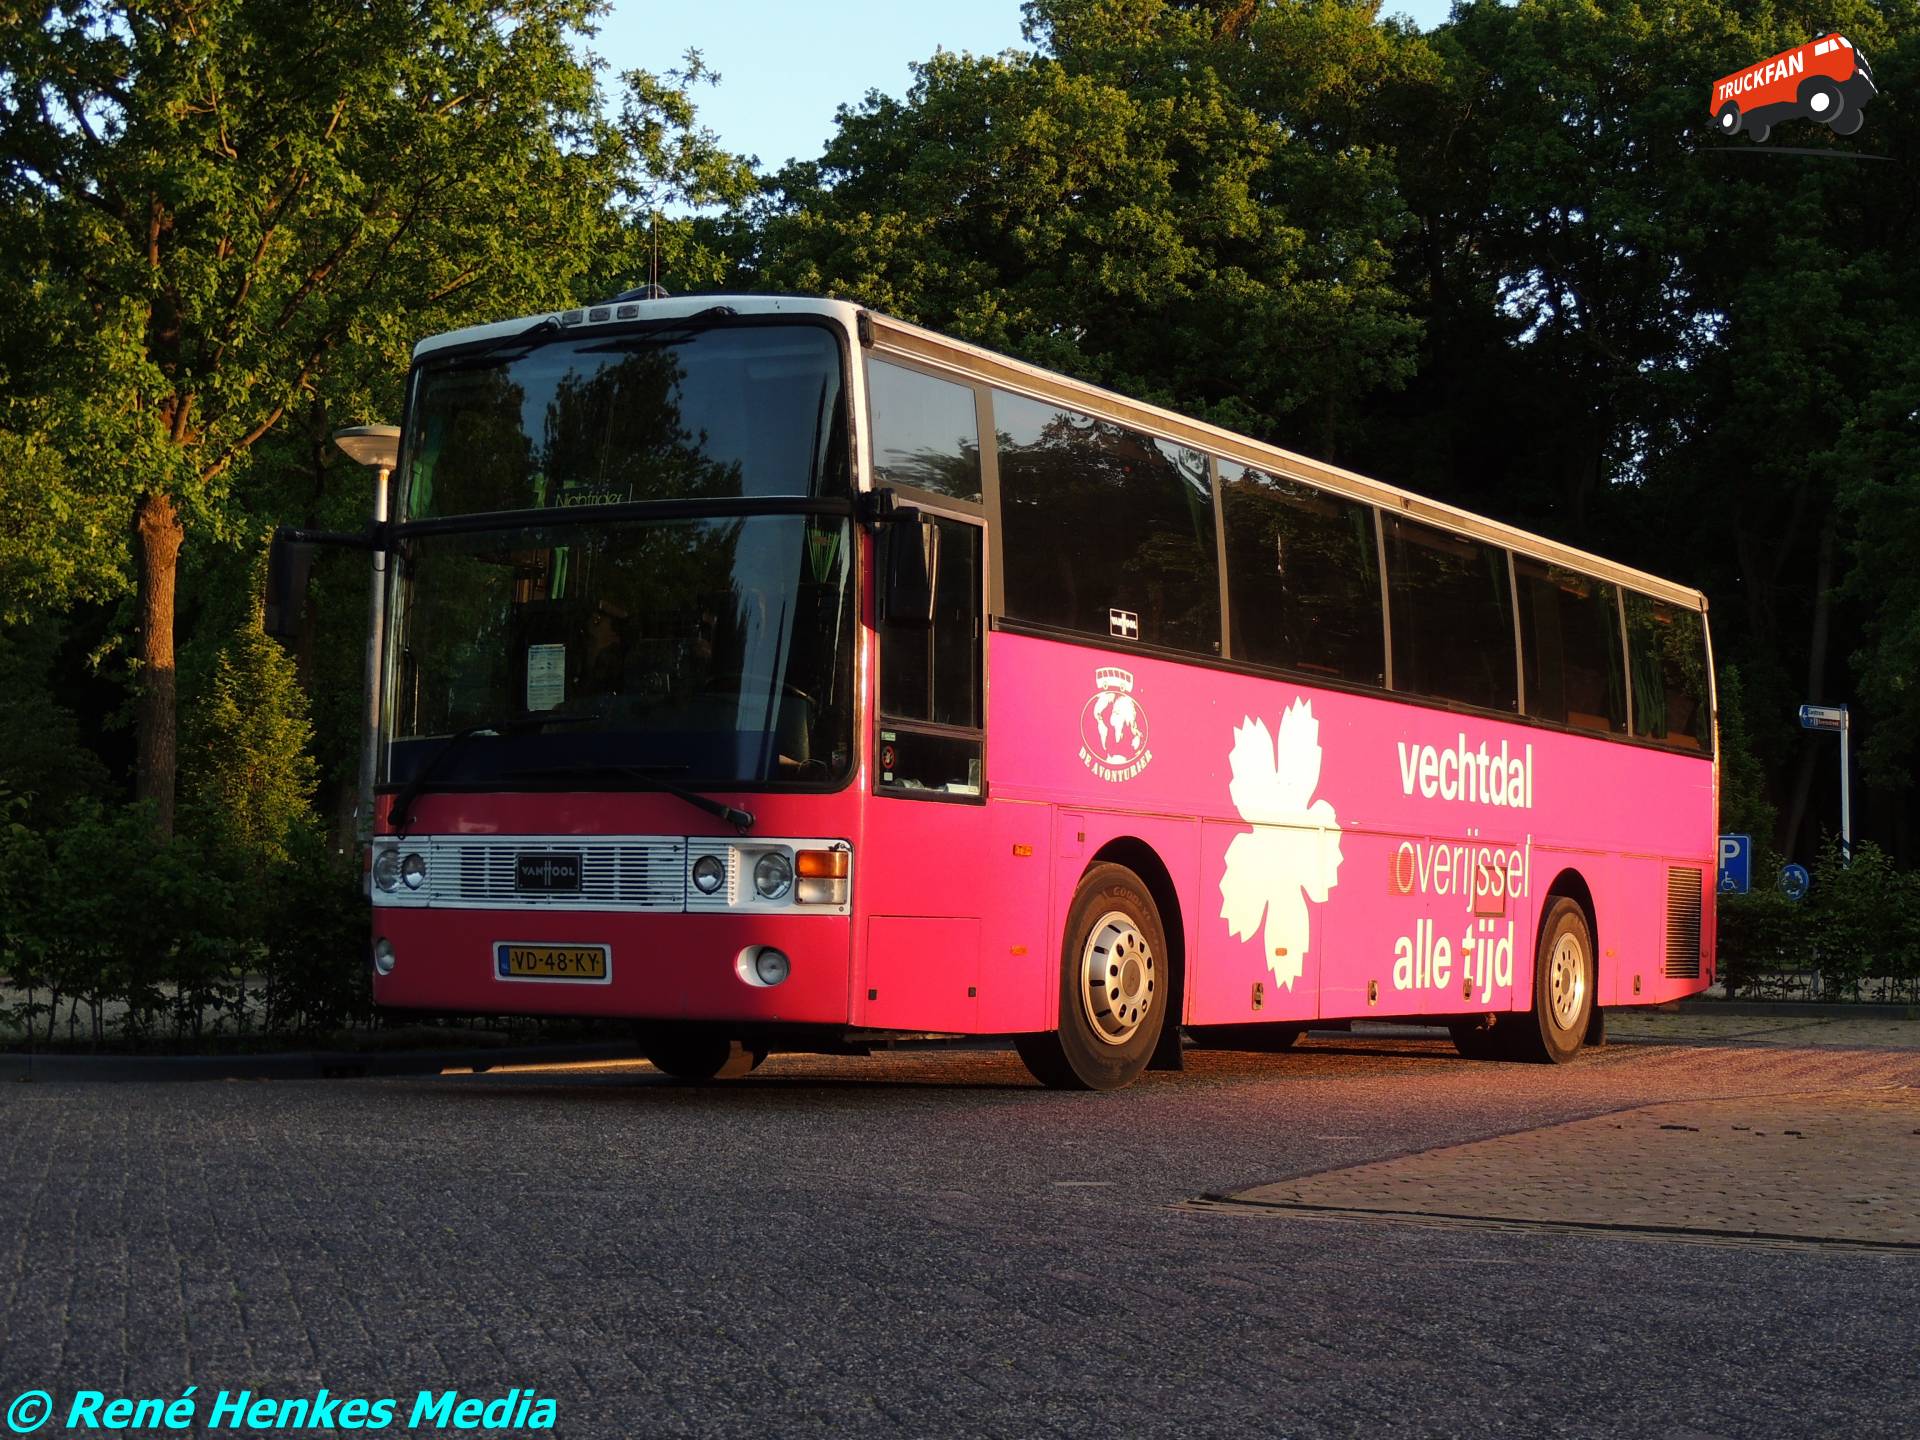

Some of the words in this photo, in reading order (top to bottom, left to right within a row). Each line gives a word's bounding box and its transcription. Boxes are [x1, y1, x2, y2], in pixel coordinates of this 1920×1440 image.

[1078, 746, 1091, 768] DE
[1090, 749, 1153, 782] AVONTURIER
[1397, 732, 1532, 809] vechtdal
[1395, 828, 1532, 912] overijssel
[1719, 839, 1741, 869] P
[513, 951, 598, 972] VD-48-KY
[1392, 918, 1452, 990] alle
[1461, 918, 1514, 1005] tijd
